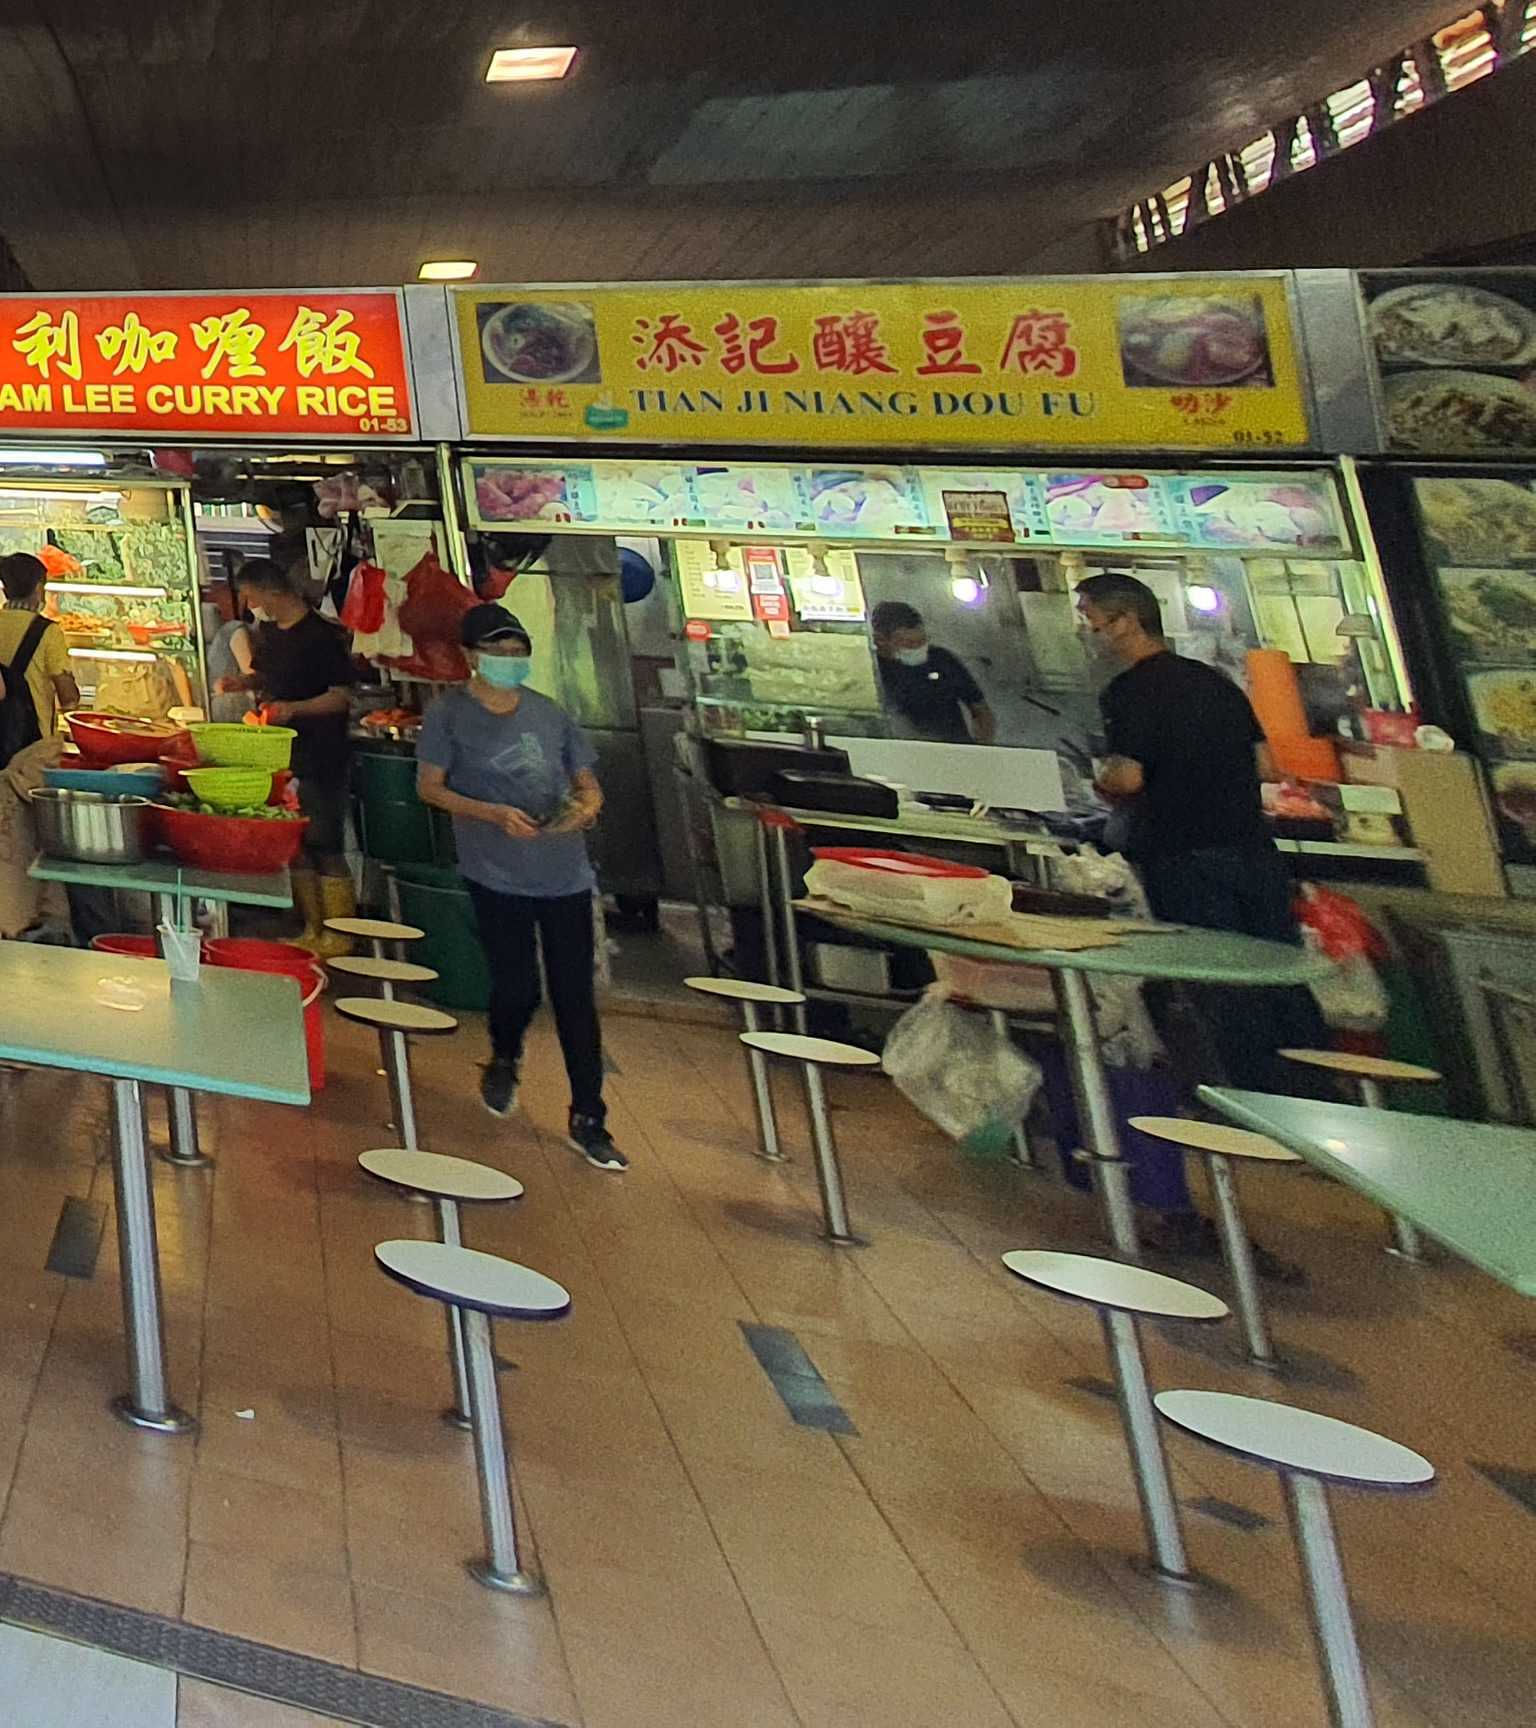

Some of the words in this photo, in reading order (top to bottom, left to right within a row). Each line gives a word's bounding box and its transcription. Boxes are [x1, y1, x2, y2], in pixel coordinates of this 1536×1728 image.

[631, 308, 1077, 377] 添記釀豆腐
[63, 384, 137, 414] LEE
[145, 384, 286, 417] CURRY
[295, 385, 398, 418] RICE
[629, 389, 724, 413] TIAN
[737, 390, 769, 413] JI
[783, 390, 918, 416] NIANG
[933, 392, 1023, 417] DOU
[1041, 391, 1096, 417] FU
[358, 417, 408, 433] 01-53
